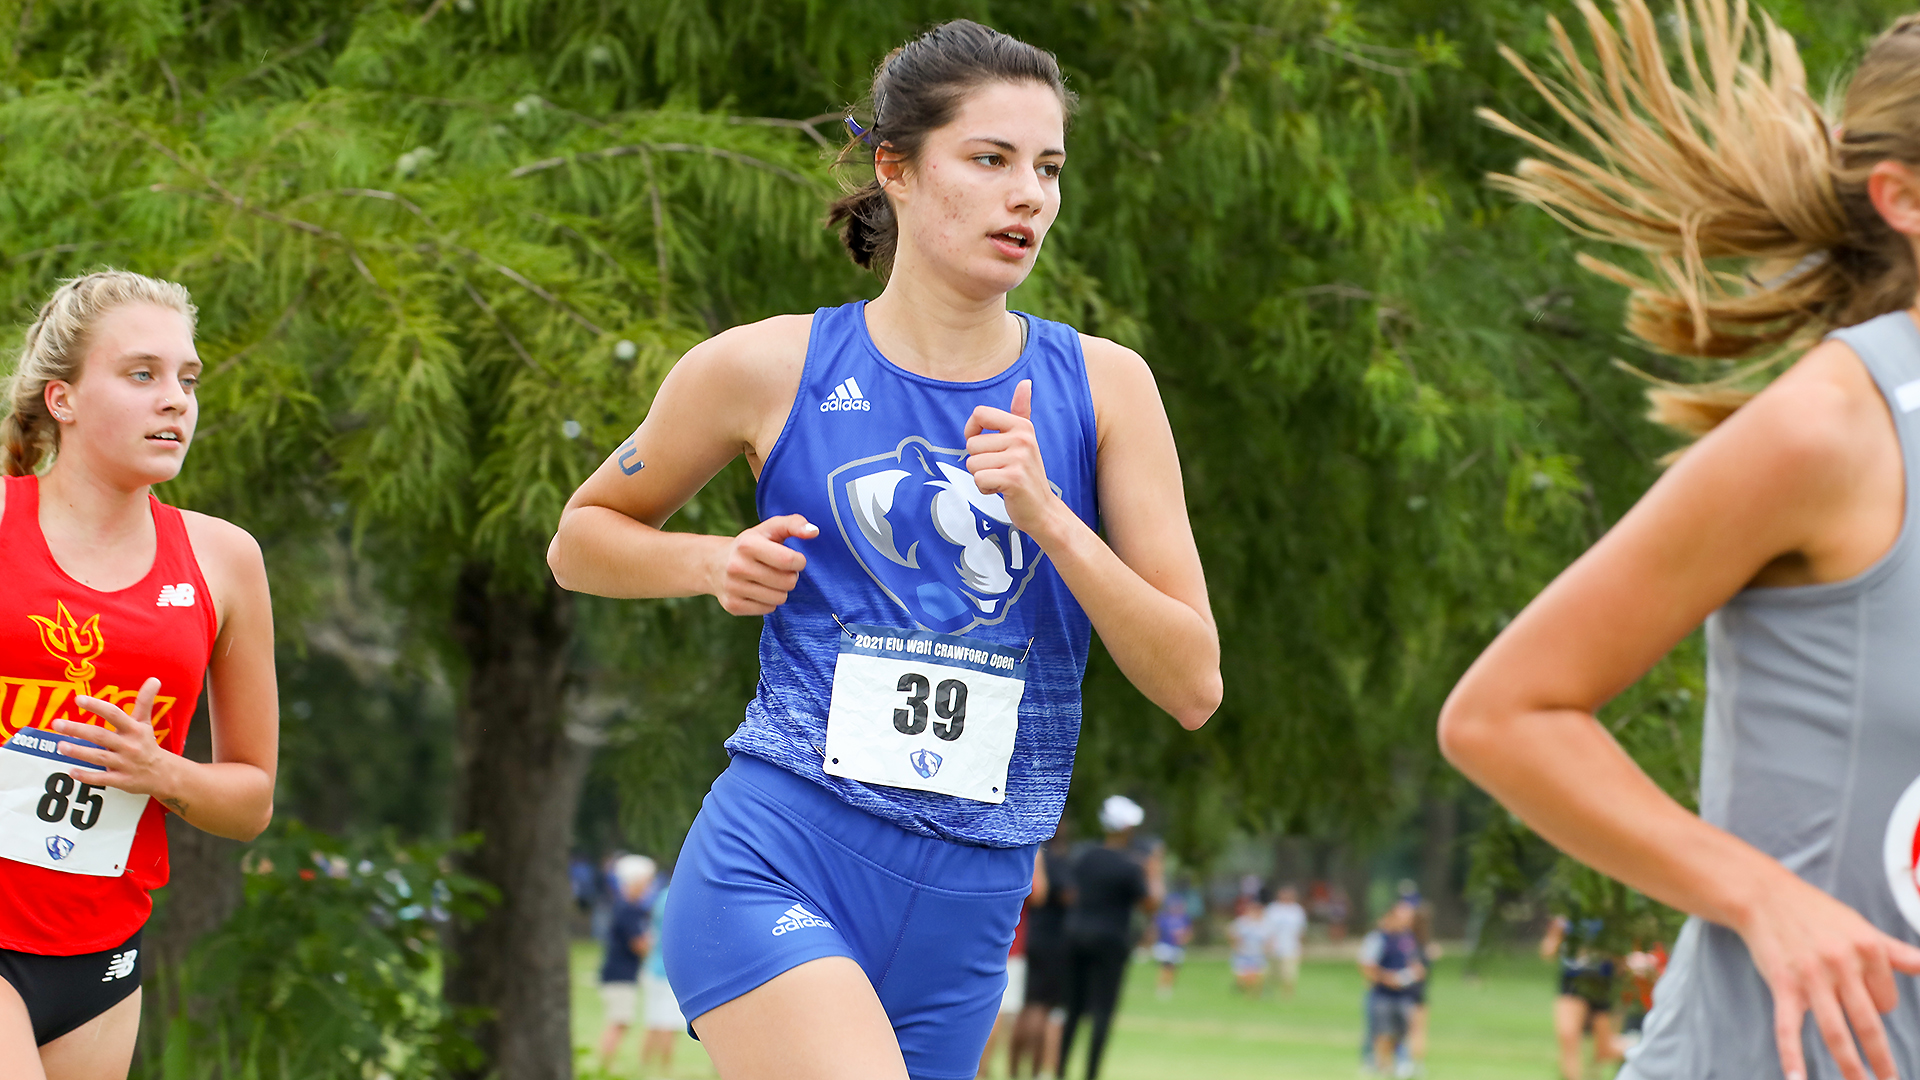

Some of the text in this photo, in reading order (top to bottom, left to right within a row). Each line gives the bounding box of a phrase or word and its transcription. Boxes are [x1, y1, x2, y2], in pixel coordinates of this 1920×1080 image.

[819, 397, 871, 412] adidas
[854, 634, 884, 650] 2021
[885, 637, 904, 652] EIU
[934, 642, 989, 665] CRAWFORD
[893, 673, 968, 742] 39
[12, 732, 39, 750] 2021
[36, 772, 106, 831] 85
